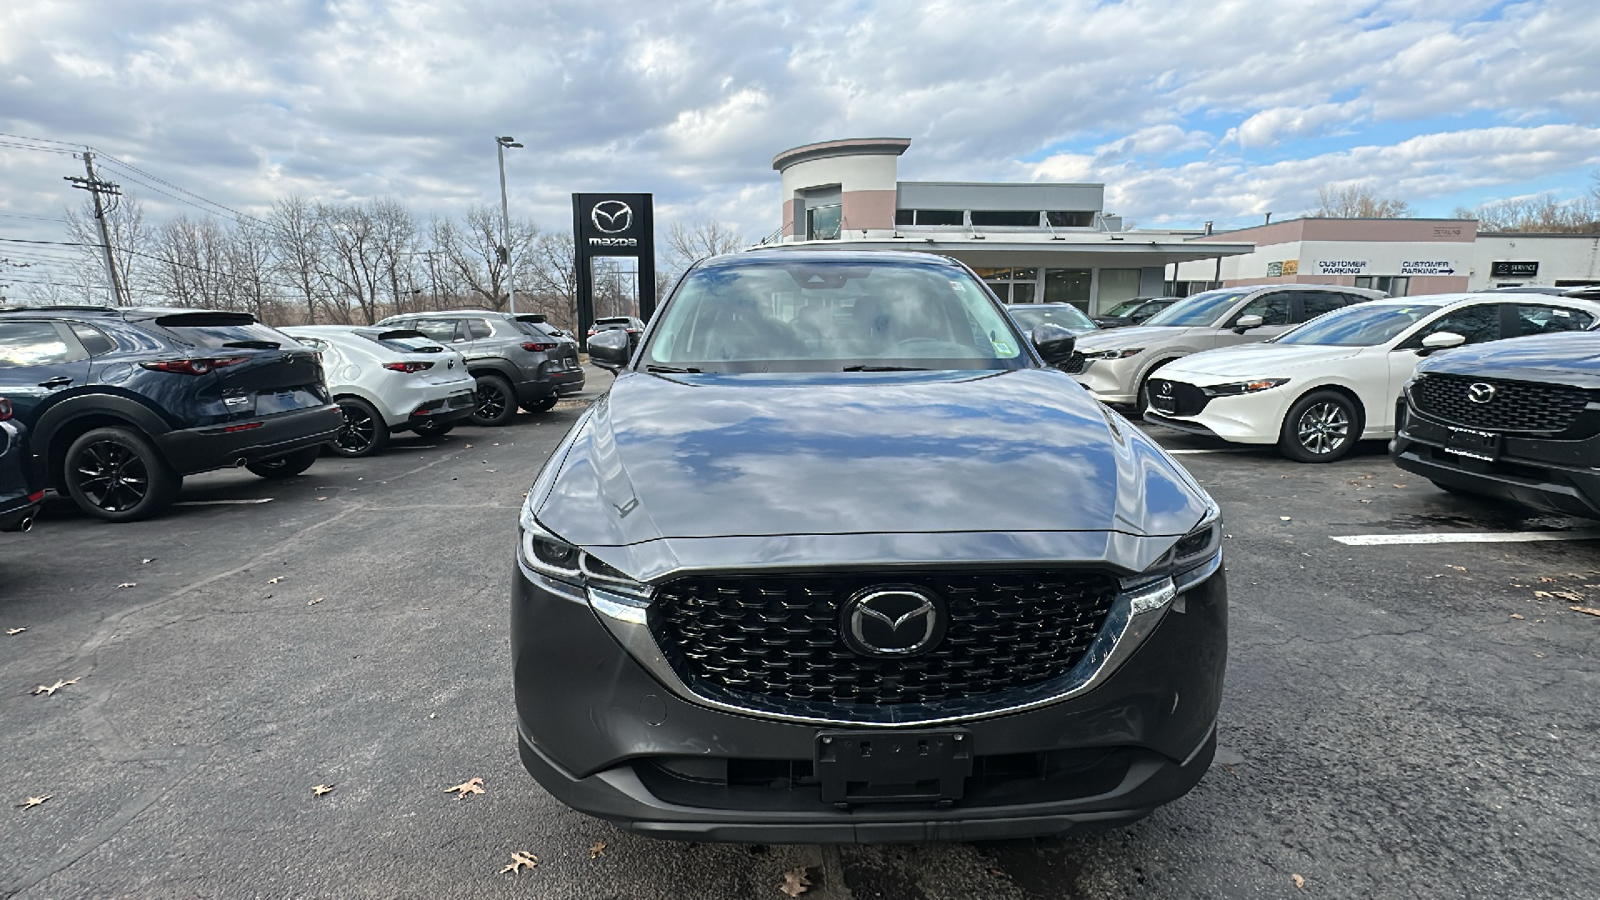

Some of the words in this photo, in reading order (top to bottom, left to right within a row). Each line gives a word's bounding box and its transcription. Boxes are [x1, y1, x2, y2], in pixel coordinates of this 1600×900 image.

[588, 237, 638, 247] mazda
[1318, 260, 1367, 268] CUSTOMER
[1401, 267, 1438, 275] PARKING
